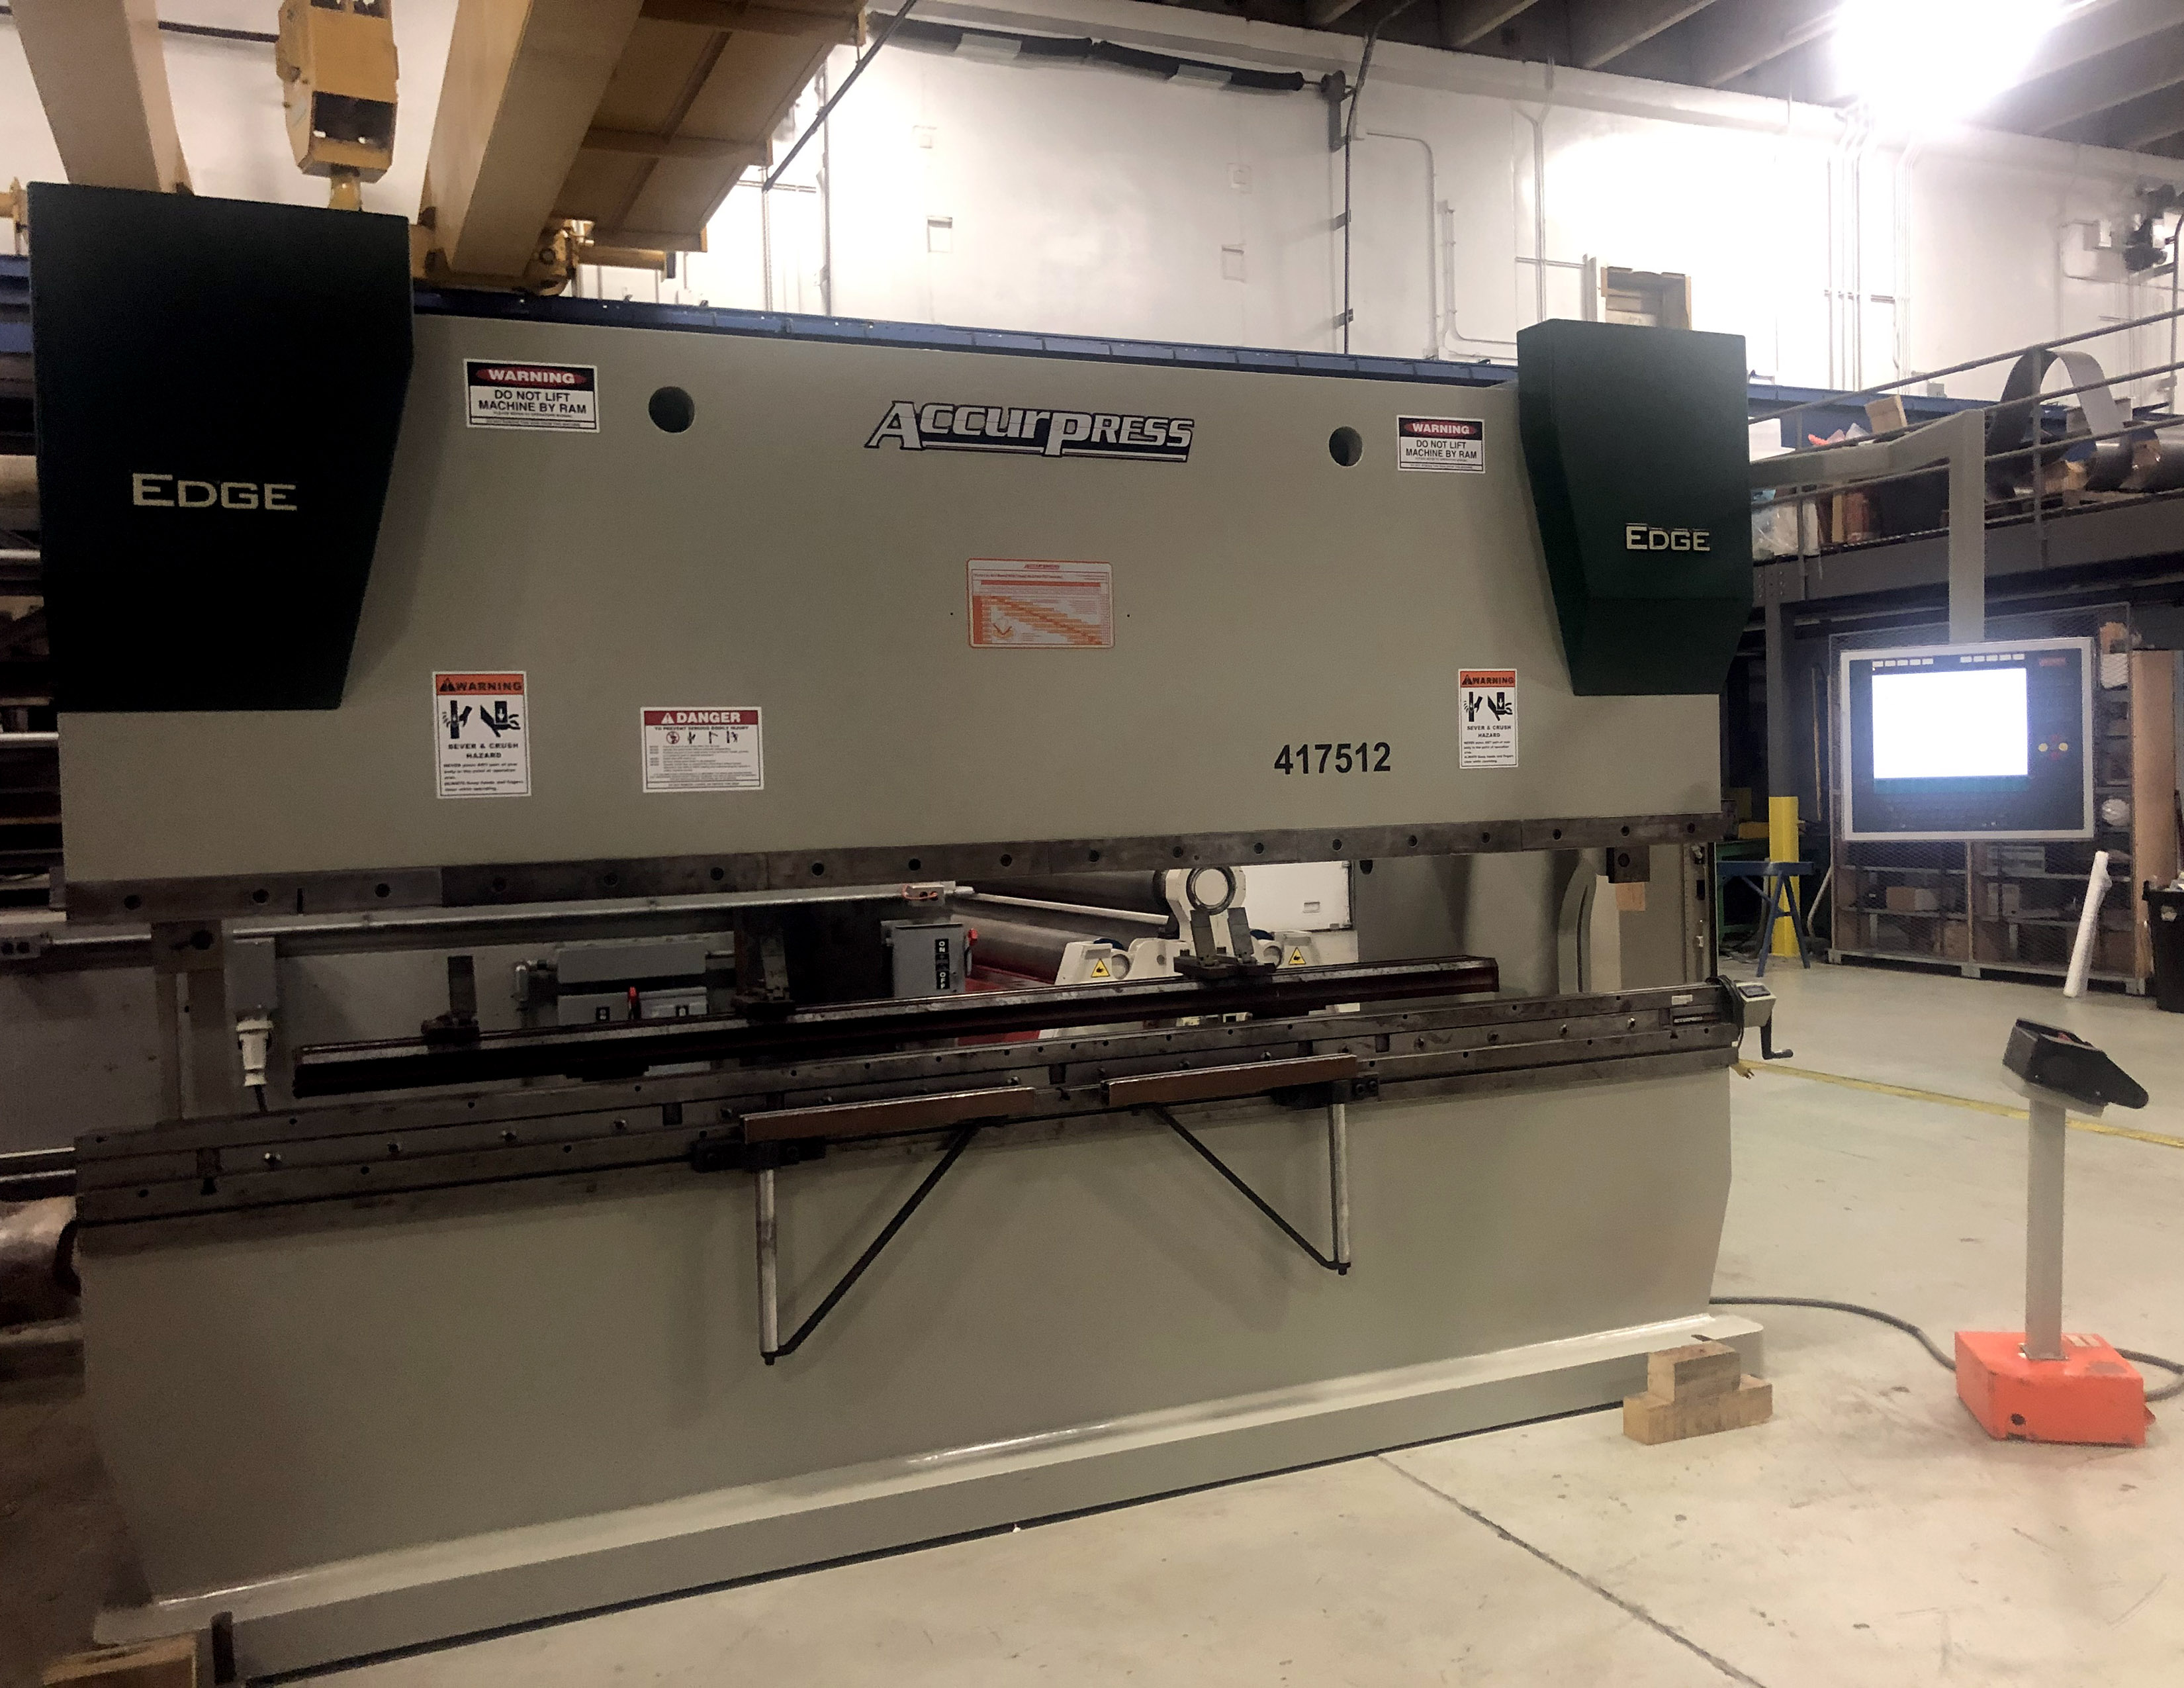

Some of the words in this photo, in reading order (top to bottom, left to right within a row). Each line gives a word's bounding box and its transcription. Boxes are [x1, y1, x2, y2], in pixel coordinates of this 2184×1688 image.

[488, 369, 575, 384] WARNING
[494, 389, 513, 400] DO
[516, 391, 541, 401] NOT
[545, 392, 570, 402] LIFT
[478, 400, 536, 412] MACHINE
[539, 402, 556, 413] BY
[559, 404, 586, 414] RAM
[1412, 423, 1470, 434] WARNING
[1416, 440, 1428, 448] DO
[1431, 440, 1447, 449] NOT
[1406, 448, 1443, 457] MACHINE
[133, 473, 297, 511] EDGE
[1626, 526, 1711, 551] EDGE
[455, 681, 522, 691] WARNING
[676, 712, 741, 724] DANGER
[1274, 741, 1391, 775] 417512
[938, 941, 946, 953] ON
